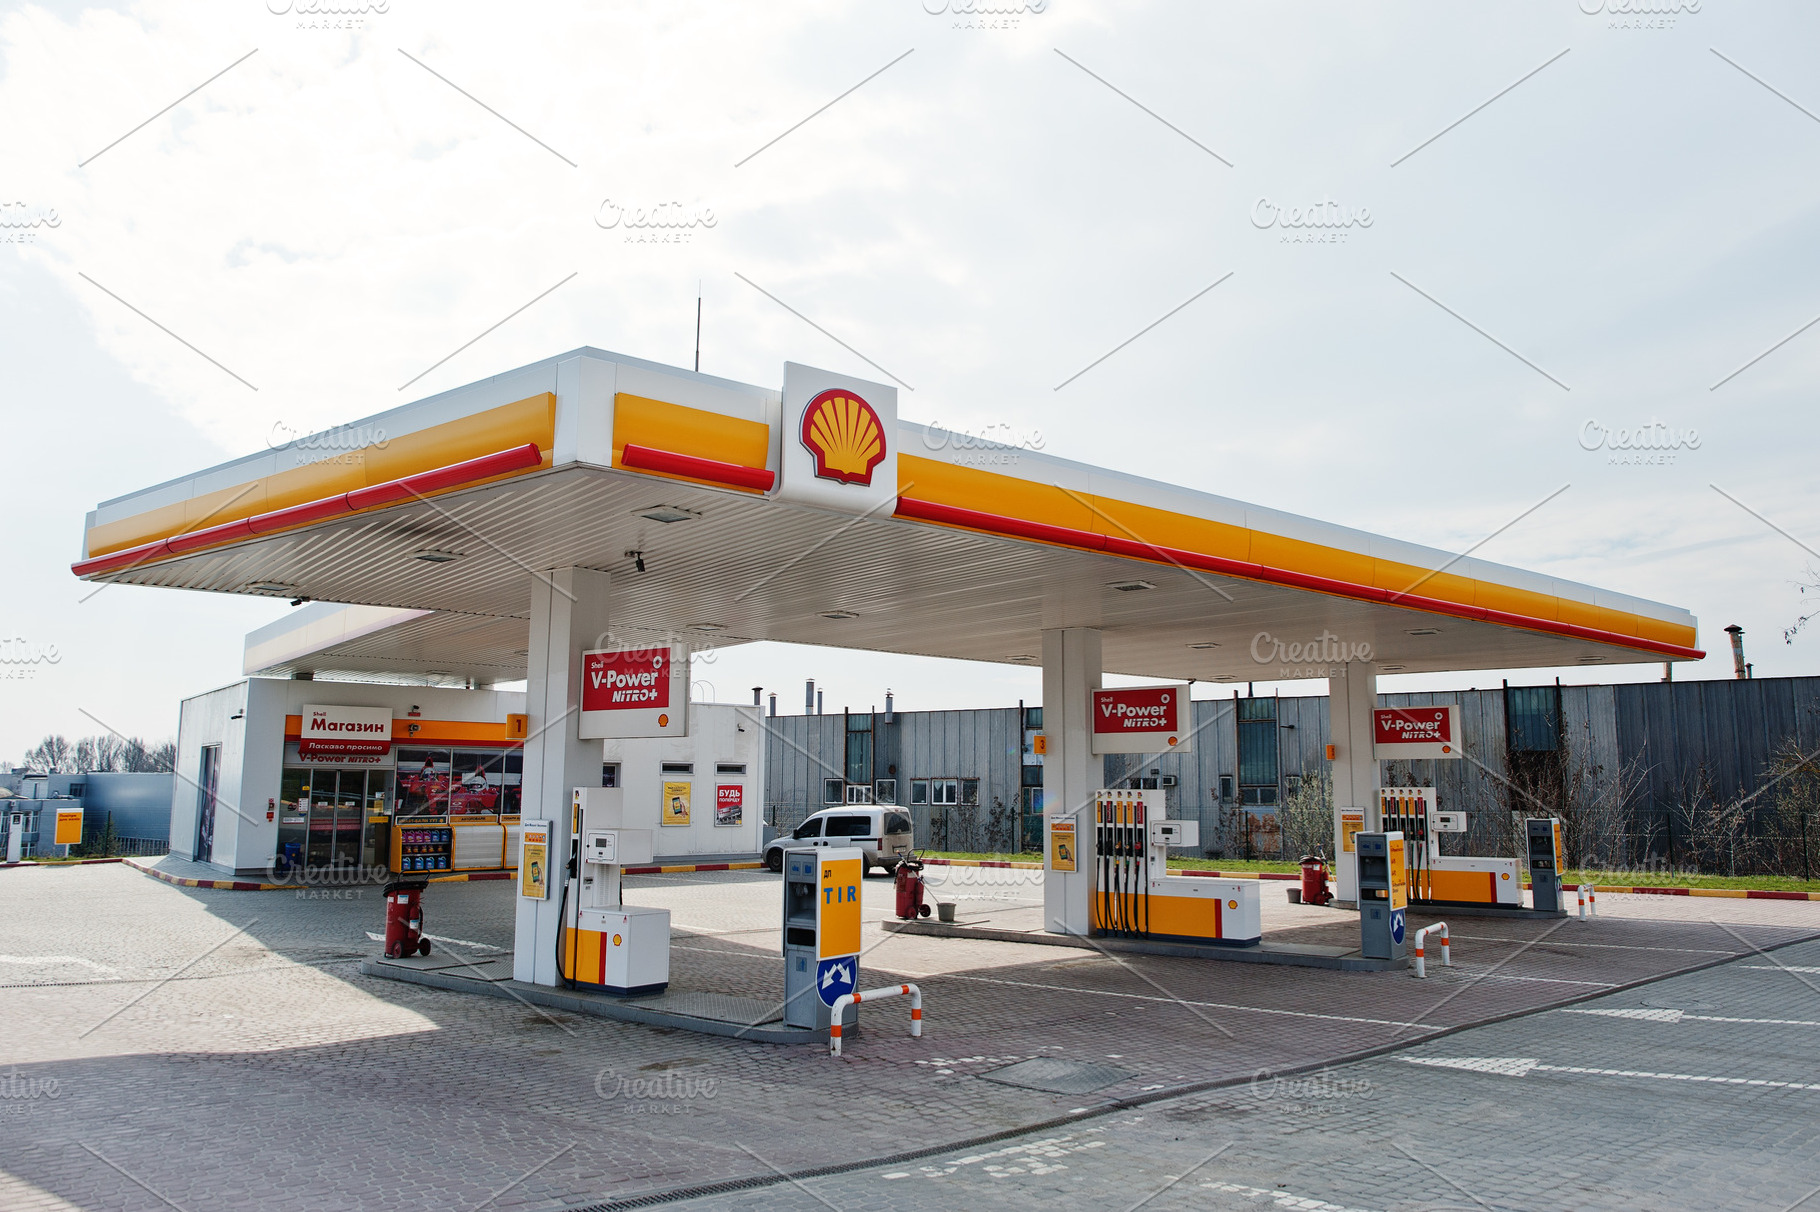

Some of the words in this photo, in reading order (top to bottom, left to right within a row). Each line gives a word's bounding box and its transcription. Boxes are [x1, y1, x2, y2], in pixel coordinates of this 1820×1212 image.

[591, 661, 604, 669] Shell
[591, 670, 659, 689] V-Power
[1101, 703, 1167, 718] V-Power
[310, 718, 384, 733] Магазин
[516, 719, 522, 733] 1
[1381, 720, 1440, 731] V-Power
[308, 742, 345, 750] Ласкаво
[719, 789, 741, 798] БУДЬ
[823, 869, 832, 879] ДП
[823, 885, 856, 905] TIR
